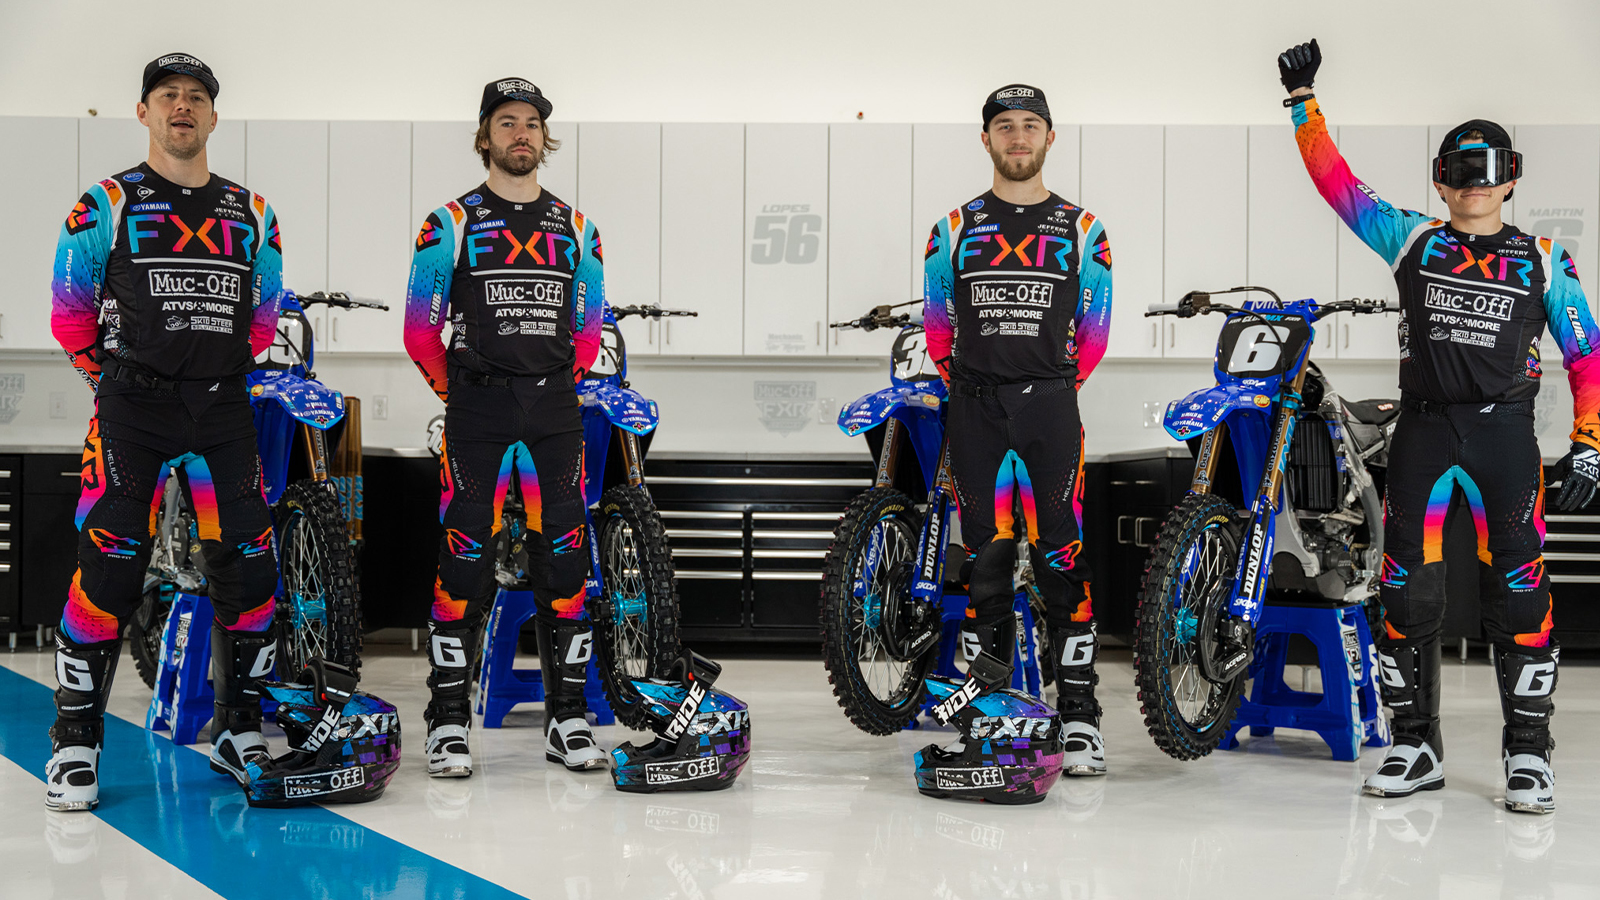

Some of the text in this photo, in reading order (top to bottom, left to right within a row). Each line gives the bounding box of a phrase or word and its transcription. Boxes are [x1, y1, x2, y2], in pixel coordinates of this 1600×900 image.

[140, 203, 171, 211] YAMAHA
[761, 204, 811, 213] LOPES
[1529, 208, 1584, 217] MARTIN
[127, 214, 255, 262] FXR
[479, 220, 505, 229] YAMAHA
[750, 214, 822, 265] 56
[973, 224, 998, 233] YAMAHA
[1037, 224, 1068, 234] JEFFERY
[466, 229, 577, 271] FXR
[958, 234, 1073, 272] FXR
[1421, 234, 1533, 287] FXR
[64, 249, 73, 294] PRO-FIT
[153, 273, 238, 297] Muc-Off
[428, 269, 446, 326] CLUBMX
[489, 283, 561, 303] Muc-Off
[575, 281, 587, 334] CLUBMX
[974, 284, 1049, 304] Muc-Off
[1098, 286, 1109, 327] PRO-FIT
[1428, 287, 1511, 318] Muc-Off
[1228, 325, 1290, 373] 6
[758, 384, 812, 398] Muc-Off
[1179, 420, 1204, 428] YAMAHA
[106, 448, 121, 487] HELIUM
[451, 457, 465, 491] HELIUM
[571, 453, 582, 486] HELIUM
[1573, 461, 1599, 479] FXR
[1062, 468, 1076, 502] HELIUM
[1205, 514, 1229, 525] DUNLOP
[1521, 489, 1537, 524] HELIUM
[923, 512, 941, 580] DUNLOP
[1243, 523, 1264, 596] DUNLOP
[432, 634, 467, 667] G
[1061, 633, 1094, 666] G
[56, 650, 94, 691] G
[1513, 662, 1555, 696] G
[664, 680, 706, 739] RIDE
